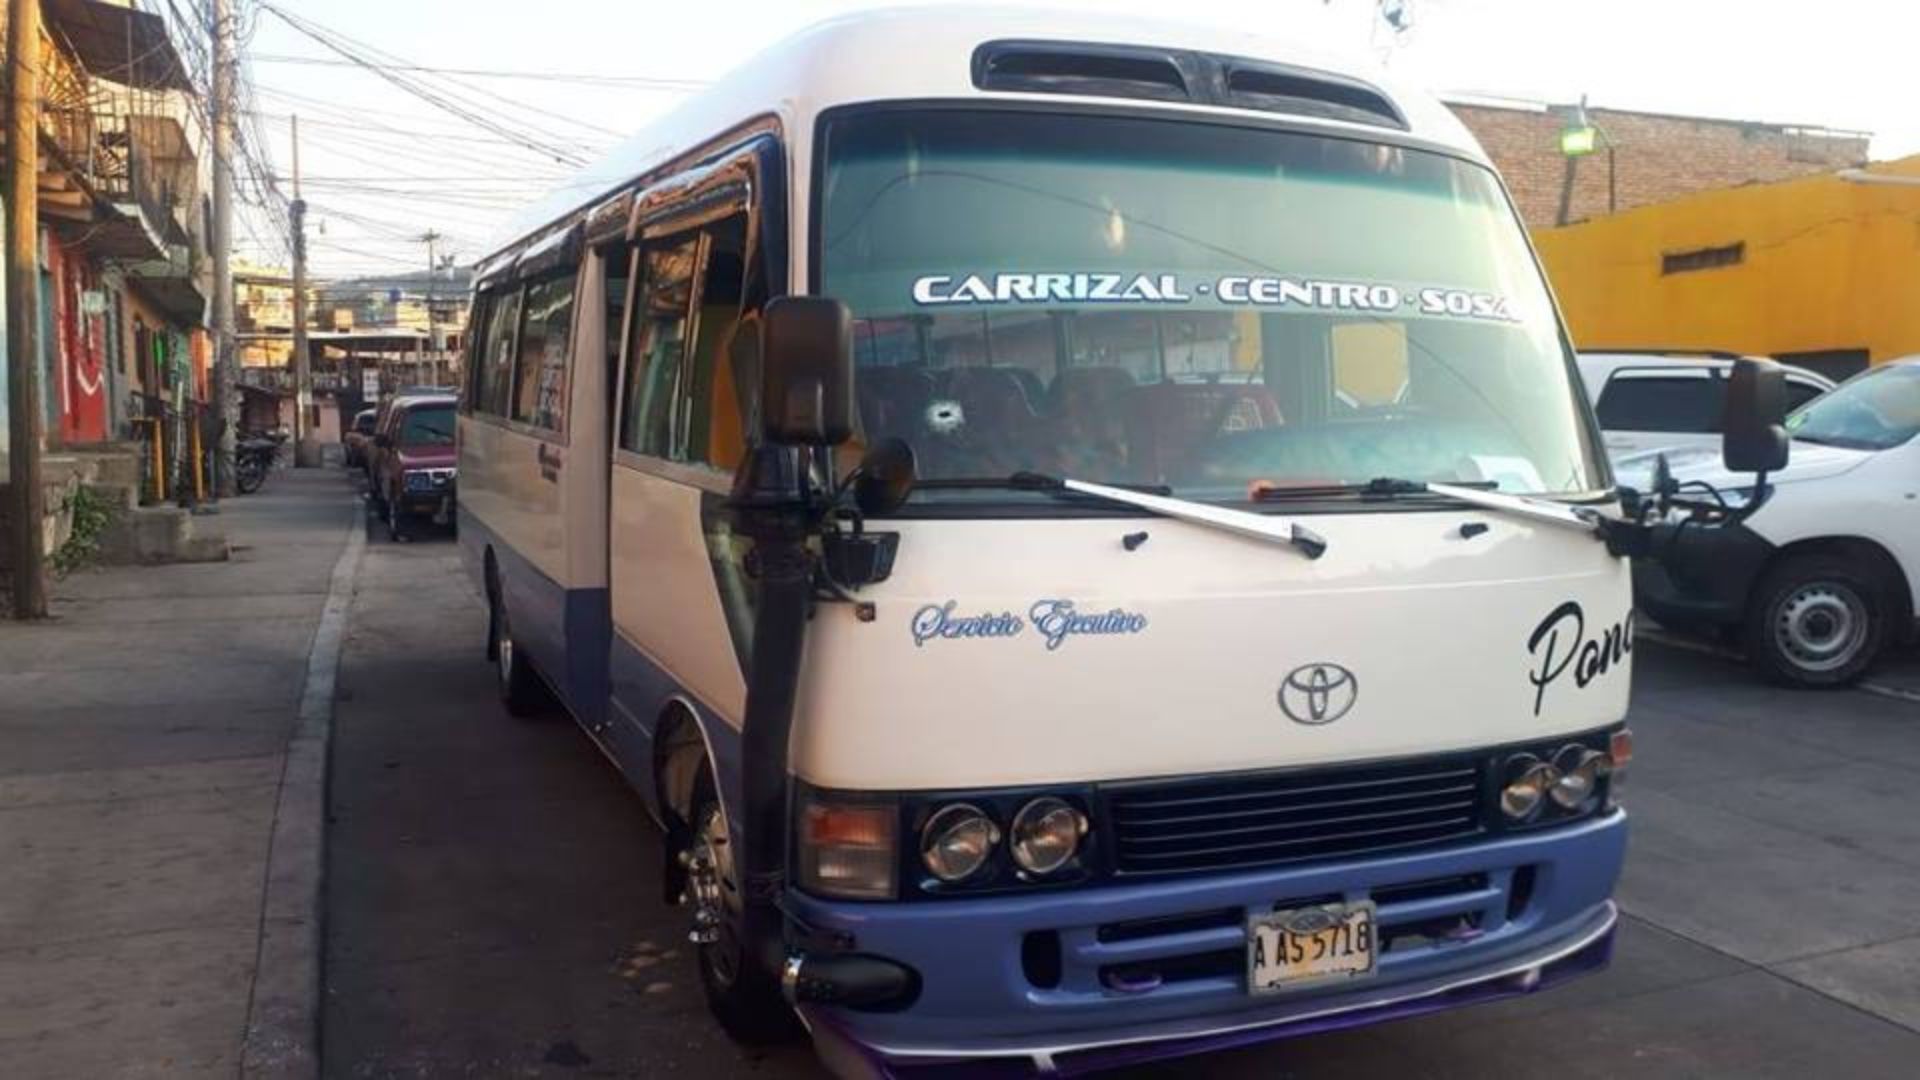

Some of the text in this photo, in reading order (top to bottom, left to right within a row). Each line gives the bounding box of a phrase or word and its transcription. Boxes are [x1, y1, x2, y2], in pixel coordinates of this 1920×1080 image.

[912, 273, 1523, 324] CARRIZAL CENTRO SOSA
[911, 599, 1147, 651] Servicio Ejecutivo
